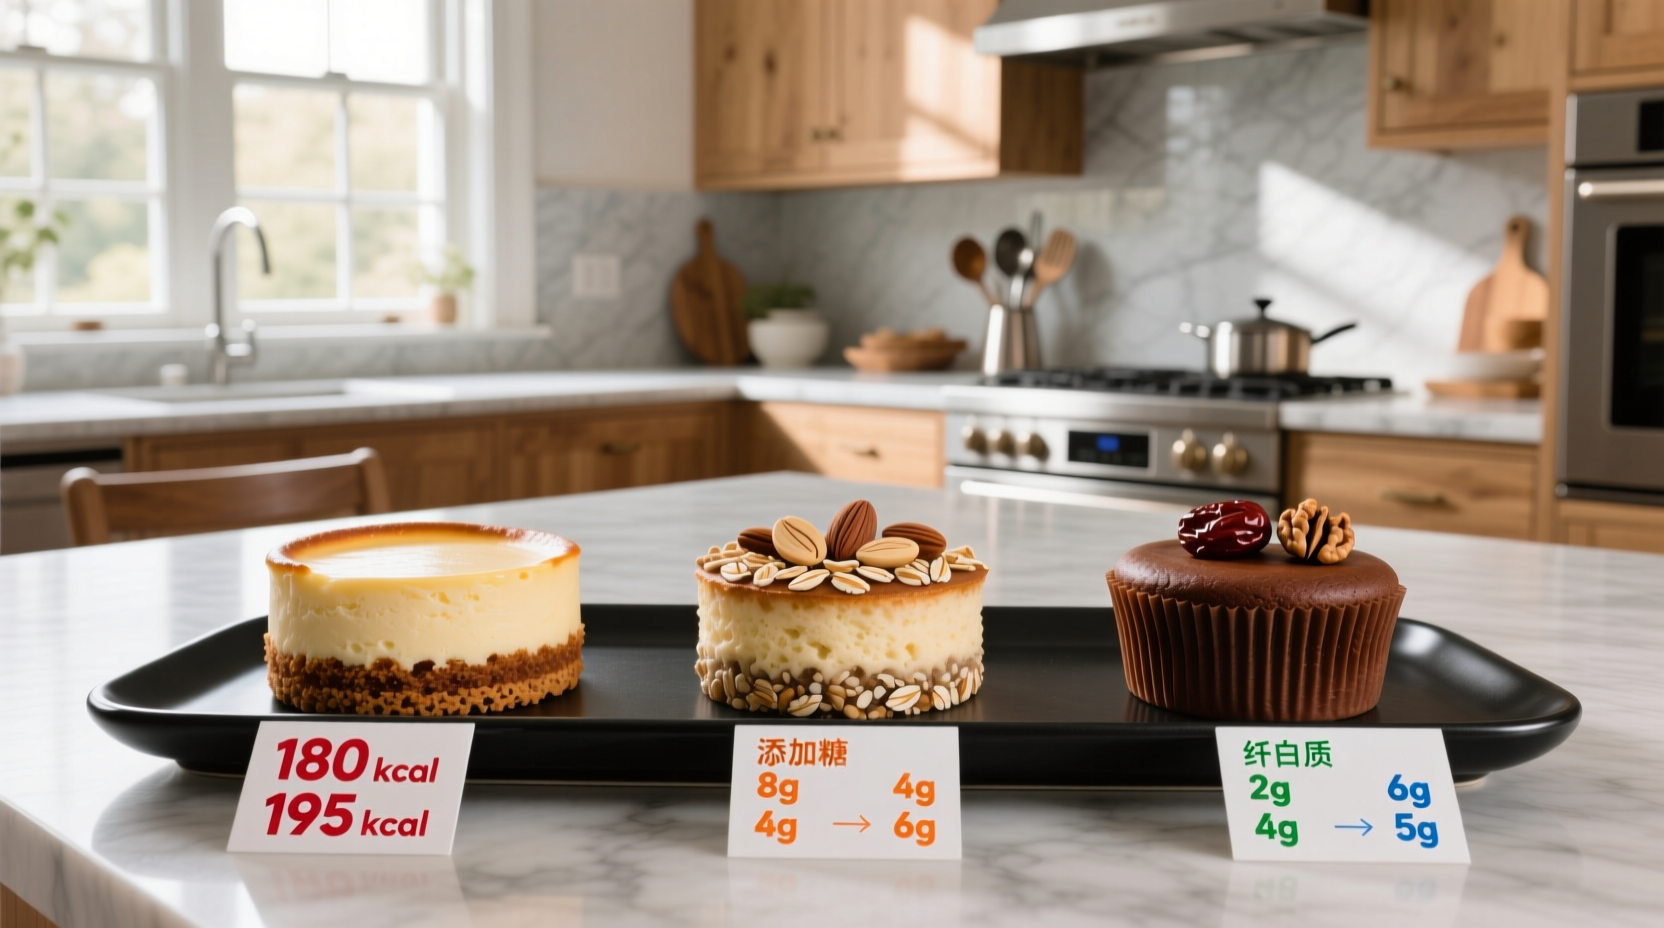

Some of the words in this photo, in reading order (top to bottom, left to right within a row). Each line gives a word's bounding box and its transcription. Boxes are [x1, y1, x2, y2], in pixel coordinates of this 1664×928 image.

[277, 737, 370, 783] 180
[373, 757, 440, 783] kcal
[757, 737, 848, 768] 添加糖
[1243, 739, 1333, 768] 纤白质
[756, 771, 799, 806] 8g
[892, 772, 936, 807] 4g
[1249, 773, 1291, 807] 2g
[1387, 773, 1432, 809] 6g
[265, 792, 357, 837] 195
[360, 809, 430, 837] kcal
[754, 810, 798, 845] 4g
[893, 811, 936, 847] 6g
[1255, 812, 1299, 848] 4g
[1394, 812, 1439, 849] 5g
